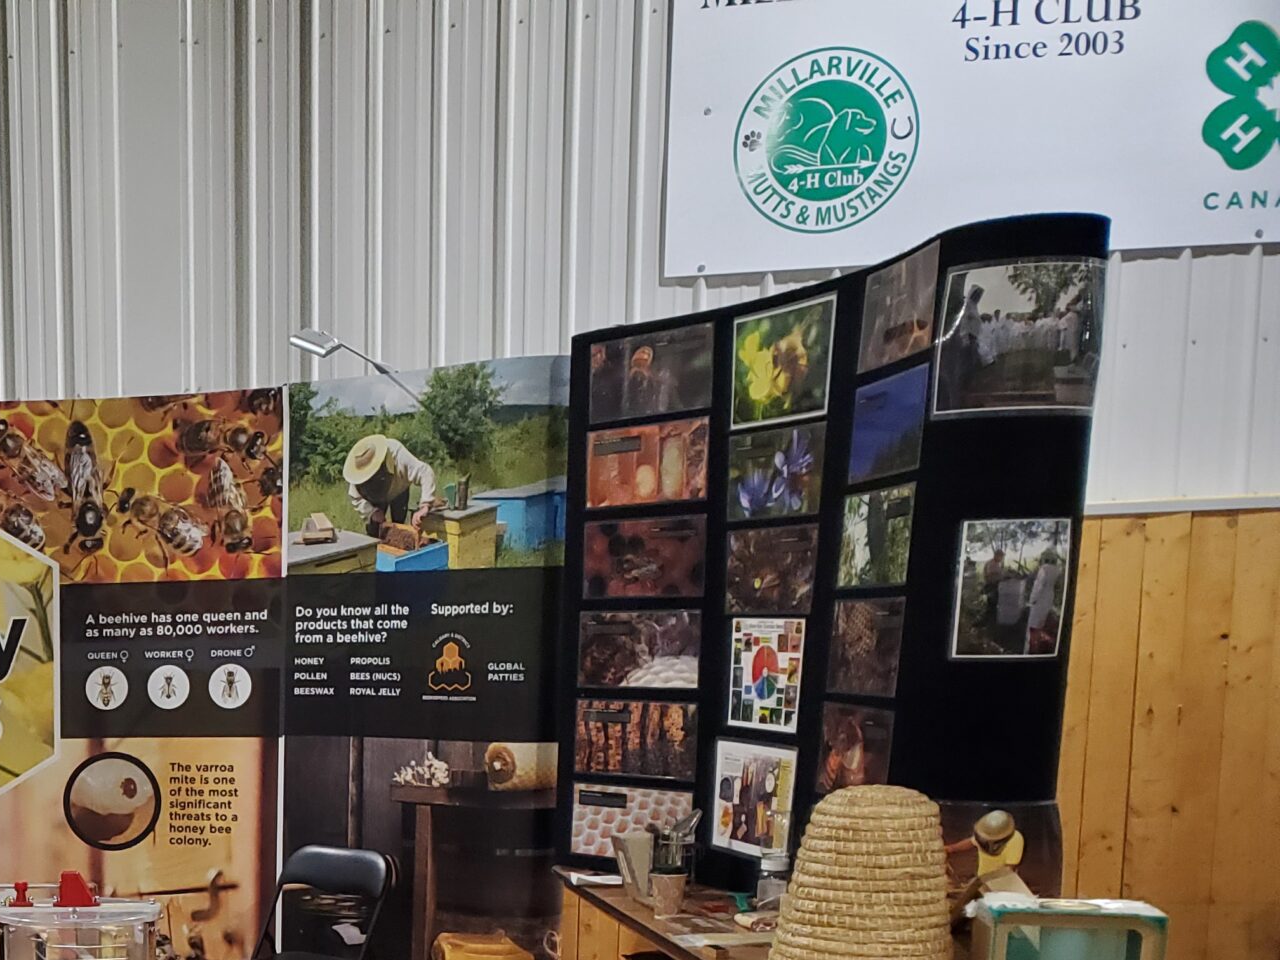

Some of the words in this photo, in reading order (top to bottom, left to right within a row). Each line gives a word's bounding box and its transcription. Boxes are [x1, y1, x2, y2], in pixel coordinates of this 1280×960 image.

[952, 0, 1020, 29] 4-H
[964, 36, 1048, 62] Since
[1057, 30, 1125, 57] 2003
[753, 56, 905, 120] MILLARVILLE
[788, 173, 820, 193] 4-H
[824, 169, 864, 187] Club
[795, 204, 810, 226] &
[815, 151, 908, 226] MUSTANGS
[295, 606, 313, 617] Do
[316, 607, 338, 619] you
[340, 605, 372, 616] know
[374, 604, 388, 615] all
[391, 604, 410, 615] the
[431, 602, 489, 616] Supported
[492, 602, 514, 615] by:
[86, 615, 95, 624] A
[99, 613, 147, 624] beehive
[151, 612, 172, 623] has
[176, 613, 199, 622] one
[203, 611, 241, 623] queen
[245, 609, 268, 620] and
[86, 628, 99, 637] as
[103, 628, 136, 638] many
[139, 627, 153, 636] as
[156, 624, 203, 637] 80,000
[207, 623, 259, 635] workers.
[295, 619, 348, 632] products
[350, 618, 374, 629] that
[376, 619, 408, 629] come
[295, 632, 324, 643] from
[326, 634, 334, 643] a
[336, 631, 388, 643] beehive?
[87, 651, 118, 660] QUEEN
[144, 650, 183, 659] WORKER
[210, 649, 242, 657] DRONE
[294, 657, 325, 665] HONEY
[350, 657, 391, 665] PROPOLIS
[487, 662, 525, 671] GLOBAL
[294, 672, 328, 680] POLLEN
[349, 672, 371, 680] BEES
[372, 672, 401, 681] (NUCS)
[487, 673, 525, 681] PATTIES
[293, 687, 335, 695] BEESWAX
[349, 687, 376, 696] ROYAL
[377, 687, 401, 697] JELLY
[169, 762, 192, 773] The
[195, 764, 234, 773] varroa
[169, 774, 196, 785] mite
[200, 774, 210, 784] is
[213, 777, 236, 785] one
[169, 786, 182, 797] of
[185, 787, 205, 797] the
[208, 787, 239, 797] most
[169, 799, 232, 811] significant
[169, 811, 212, 822] threats
[215, 812, 228, 822] to
[231, 814, 238, 822] a
[169, 823, 206, 835] honey
[209, 823, 232, 834] bee
[169, 835, 212, 848] colony.
